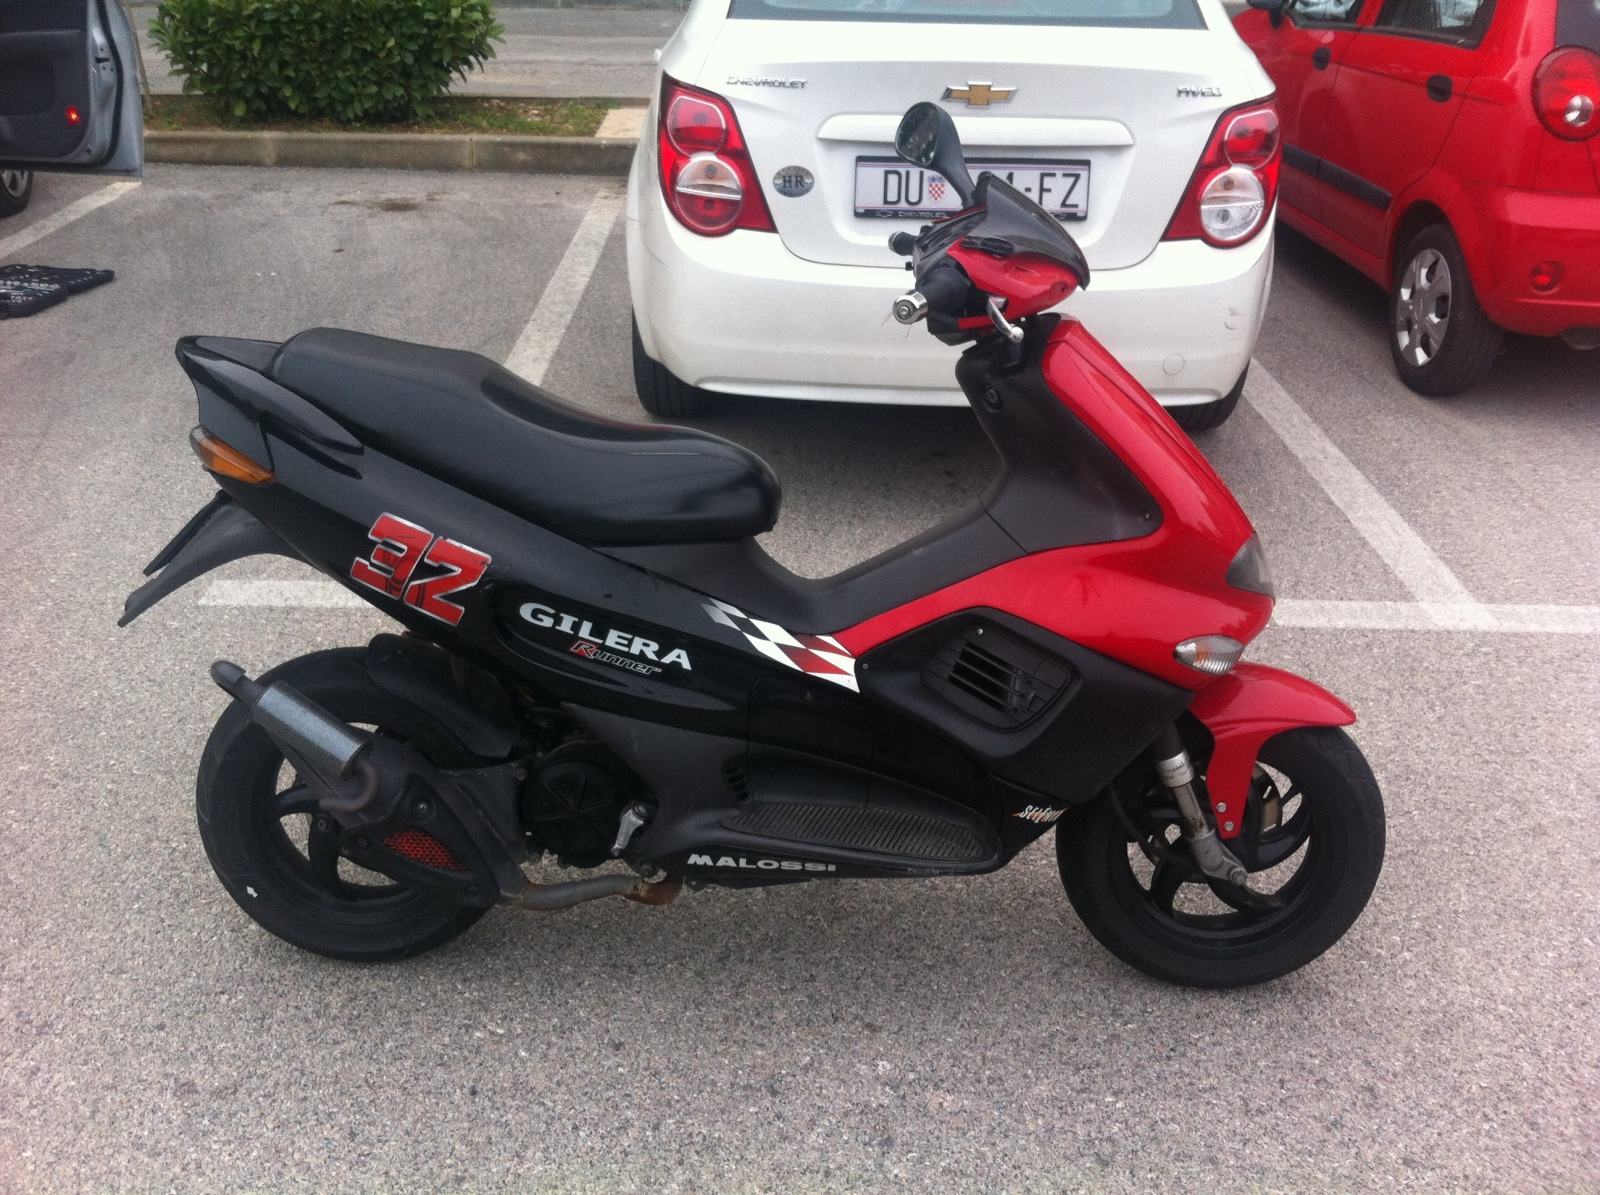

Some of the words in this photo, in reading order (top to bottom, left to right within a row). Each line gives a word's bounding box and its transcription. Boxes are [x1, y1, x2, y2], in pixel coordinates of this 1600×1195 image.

[726, 75, 808, 89] CHEVROLET
[782, 175, 805, 188] HR
[883, 169, 924, 206] DU
[350, 511, 492, 627] 32
[519, 602, 692, 671] GILERA
[570, 640, 663, 676] Runner
[687, 853, 837, 872] MALOSSI
